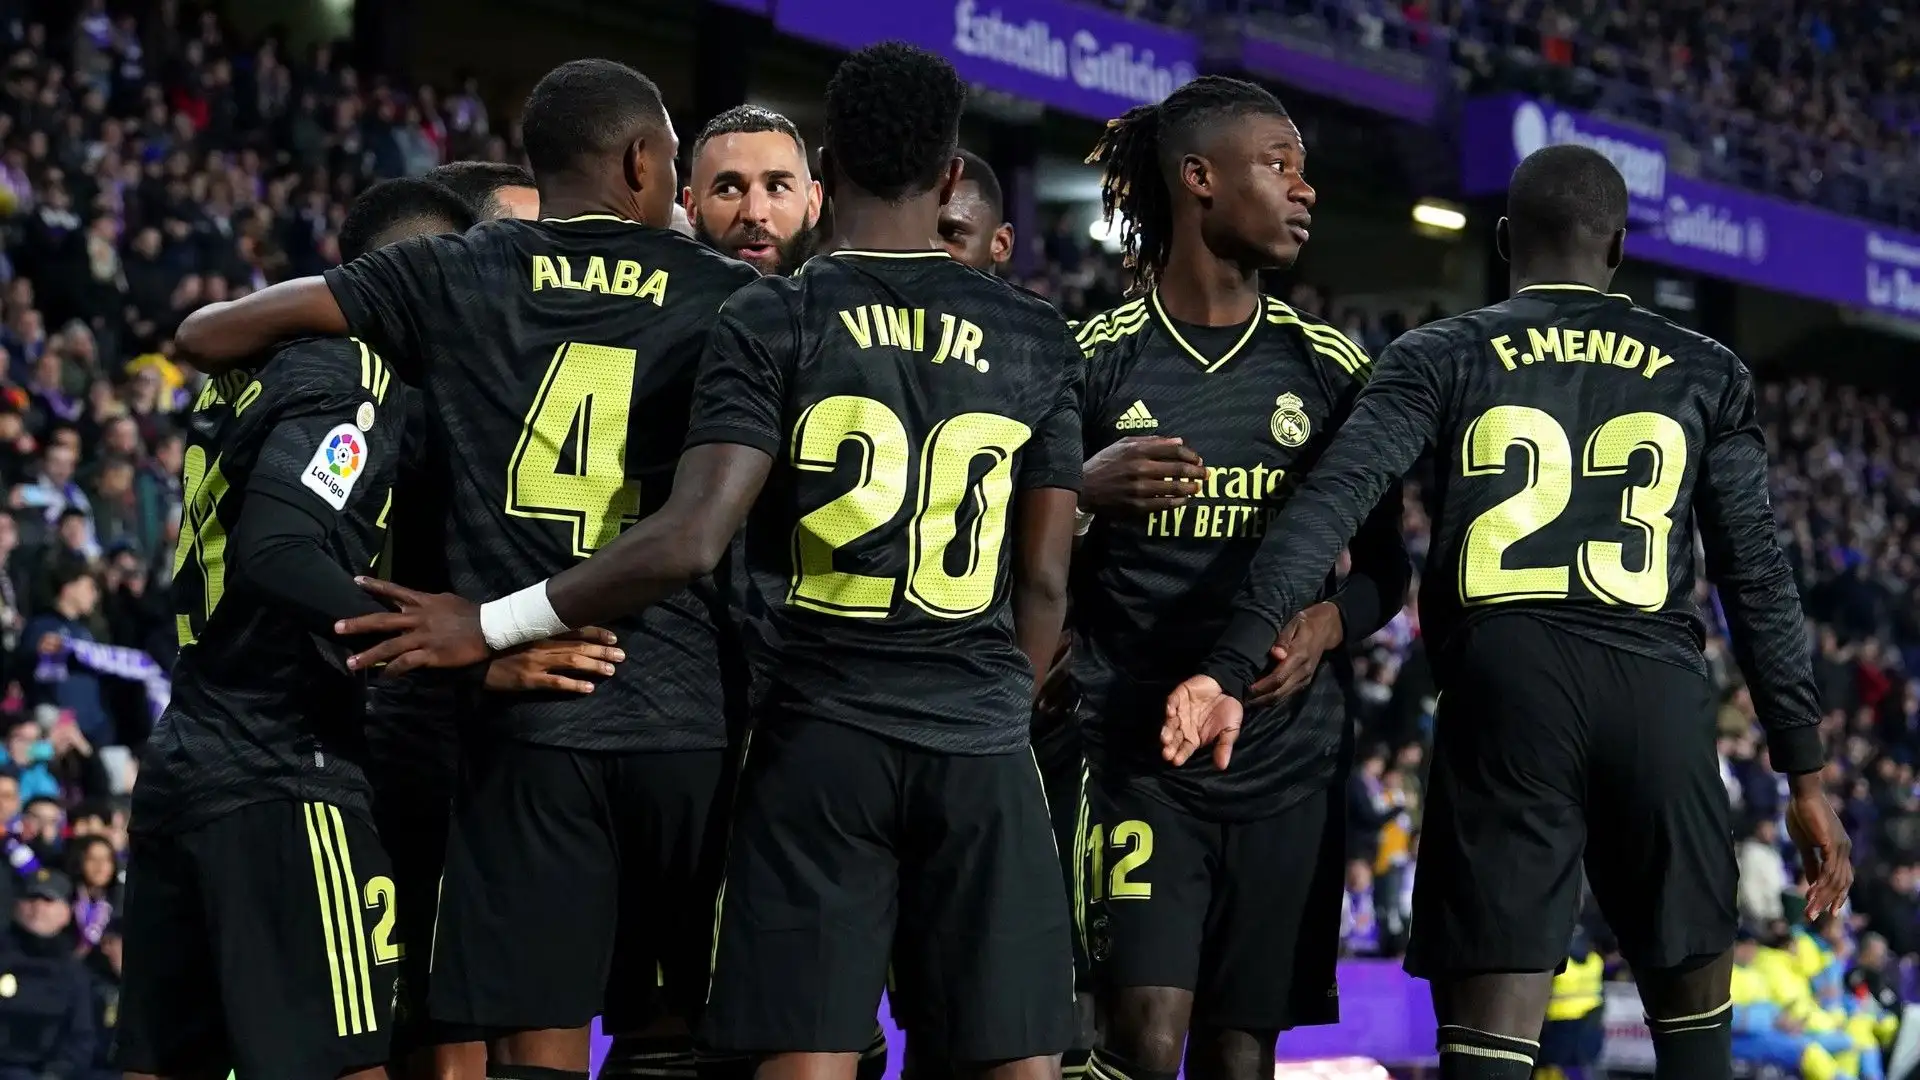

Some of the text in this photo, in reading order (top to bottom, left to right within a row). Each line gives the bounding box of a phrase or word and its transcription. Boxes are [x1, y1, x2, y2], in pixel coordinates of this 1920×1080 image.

[532, 255, 669, 307] ALABA
[839, 304, 990, 373] VINI JR.
[1490, 327, 1674, 379] F.MENDY
[505, 342, 641, 558] 4
[1116, 417, 1158, 430] adidas
[311, 466, 345, 498] LaLiga
[785, 395, 1032, 619] 20
[1458, 405, 1687, 612] 23
[1147, 505, 1187, 537] FLY
[1087, 820, 1153, 904] 12
